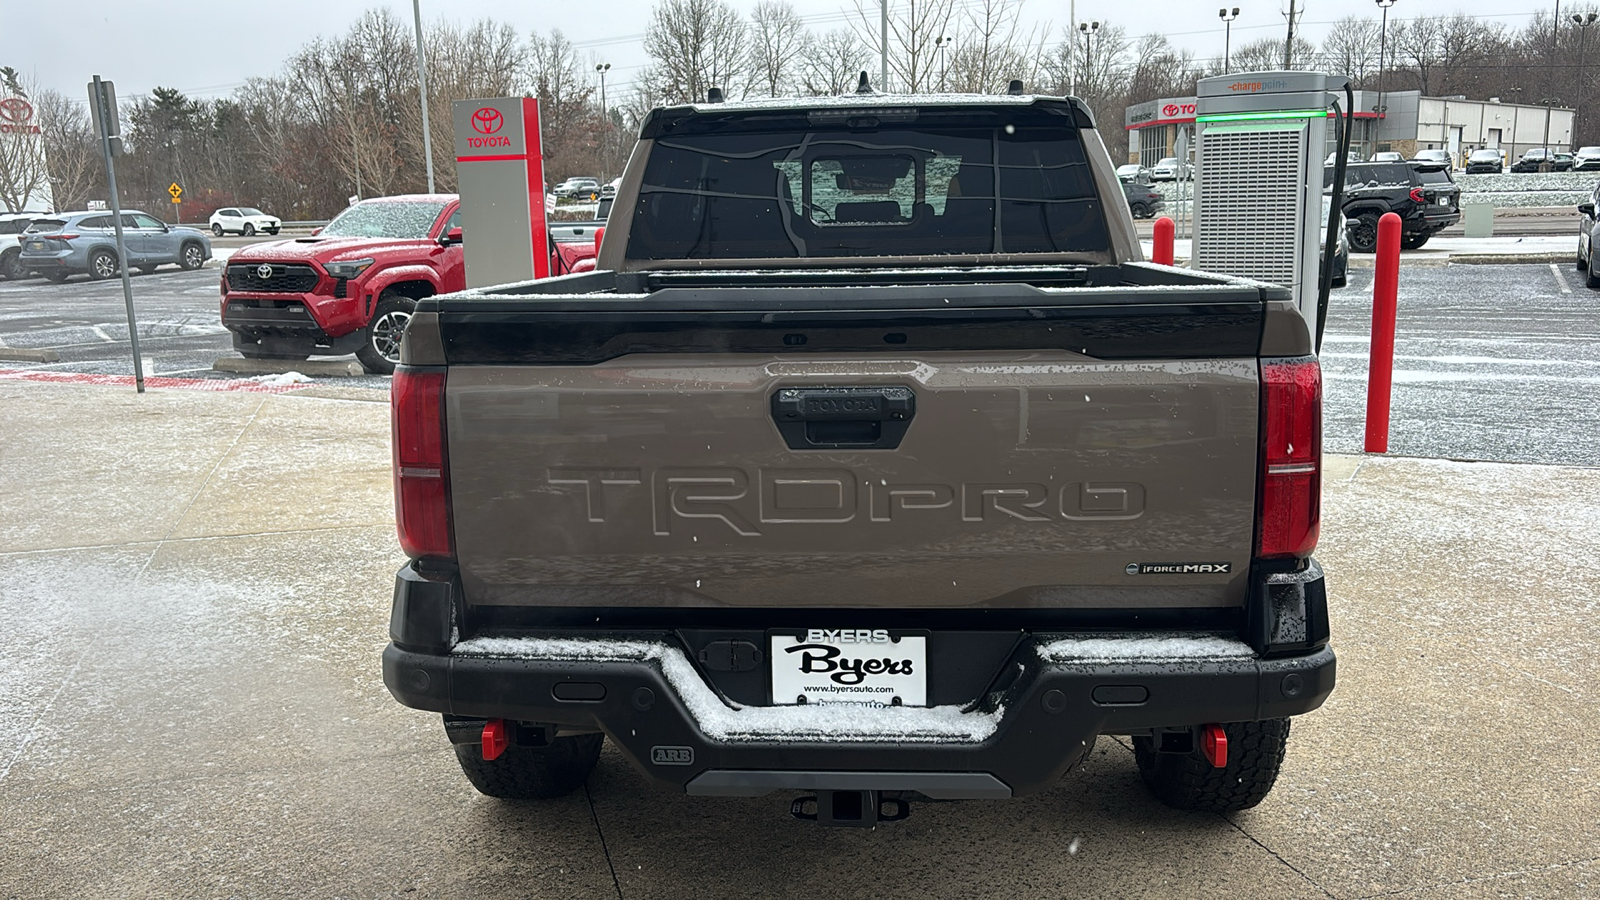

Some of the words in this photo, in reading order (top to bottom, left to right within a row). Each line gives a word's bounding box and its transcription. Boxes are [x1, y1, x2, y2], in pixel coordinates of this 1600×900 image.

[1180, 104, 1197, 114] TO
[0, 124, 41, 134] OYOTA
[467, 136, 511, 148] TOYOTA
[809, 399, 877, 412] TOYOTA
[547, 467, 857, 535] TRD
[870, 481, 1146, 521] PRO
[807, 629, 888, 642] BYERS
[784, 644, 914, 685] Byers
[804, 685, 894, 694] www.byersauto.com
[655, 749, 691, 762] ARB
